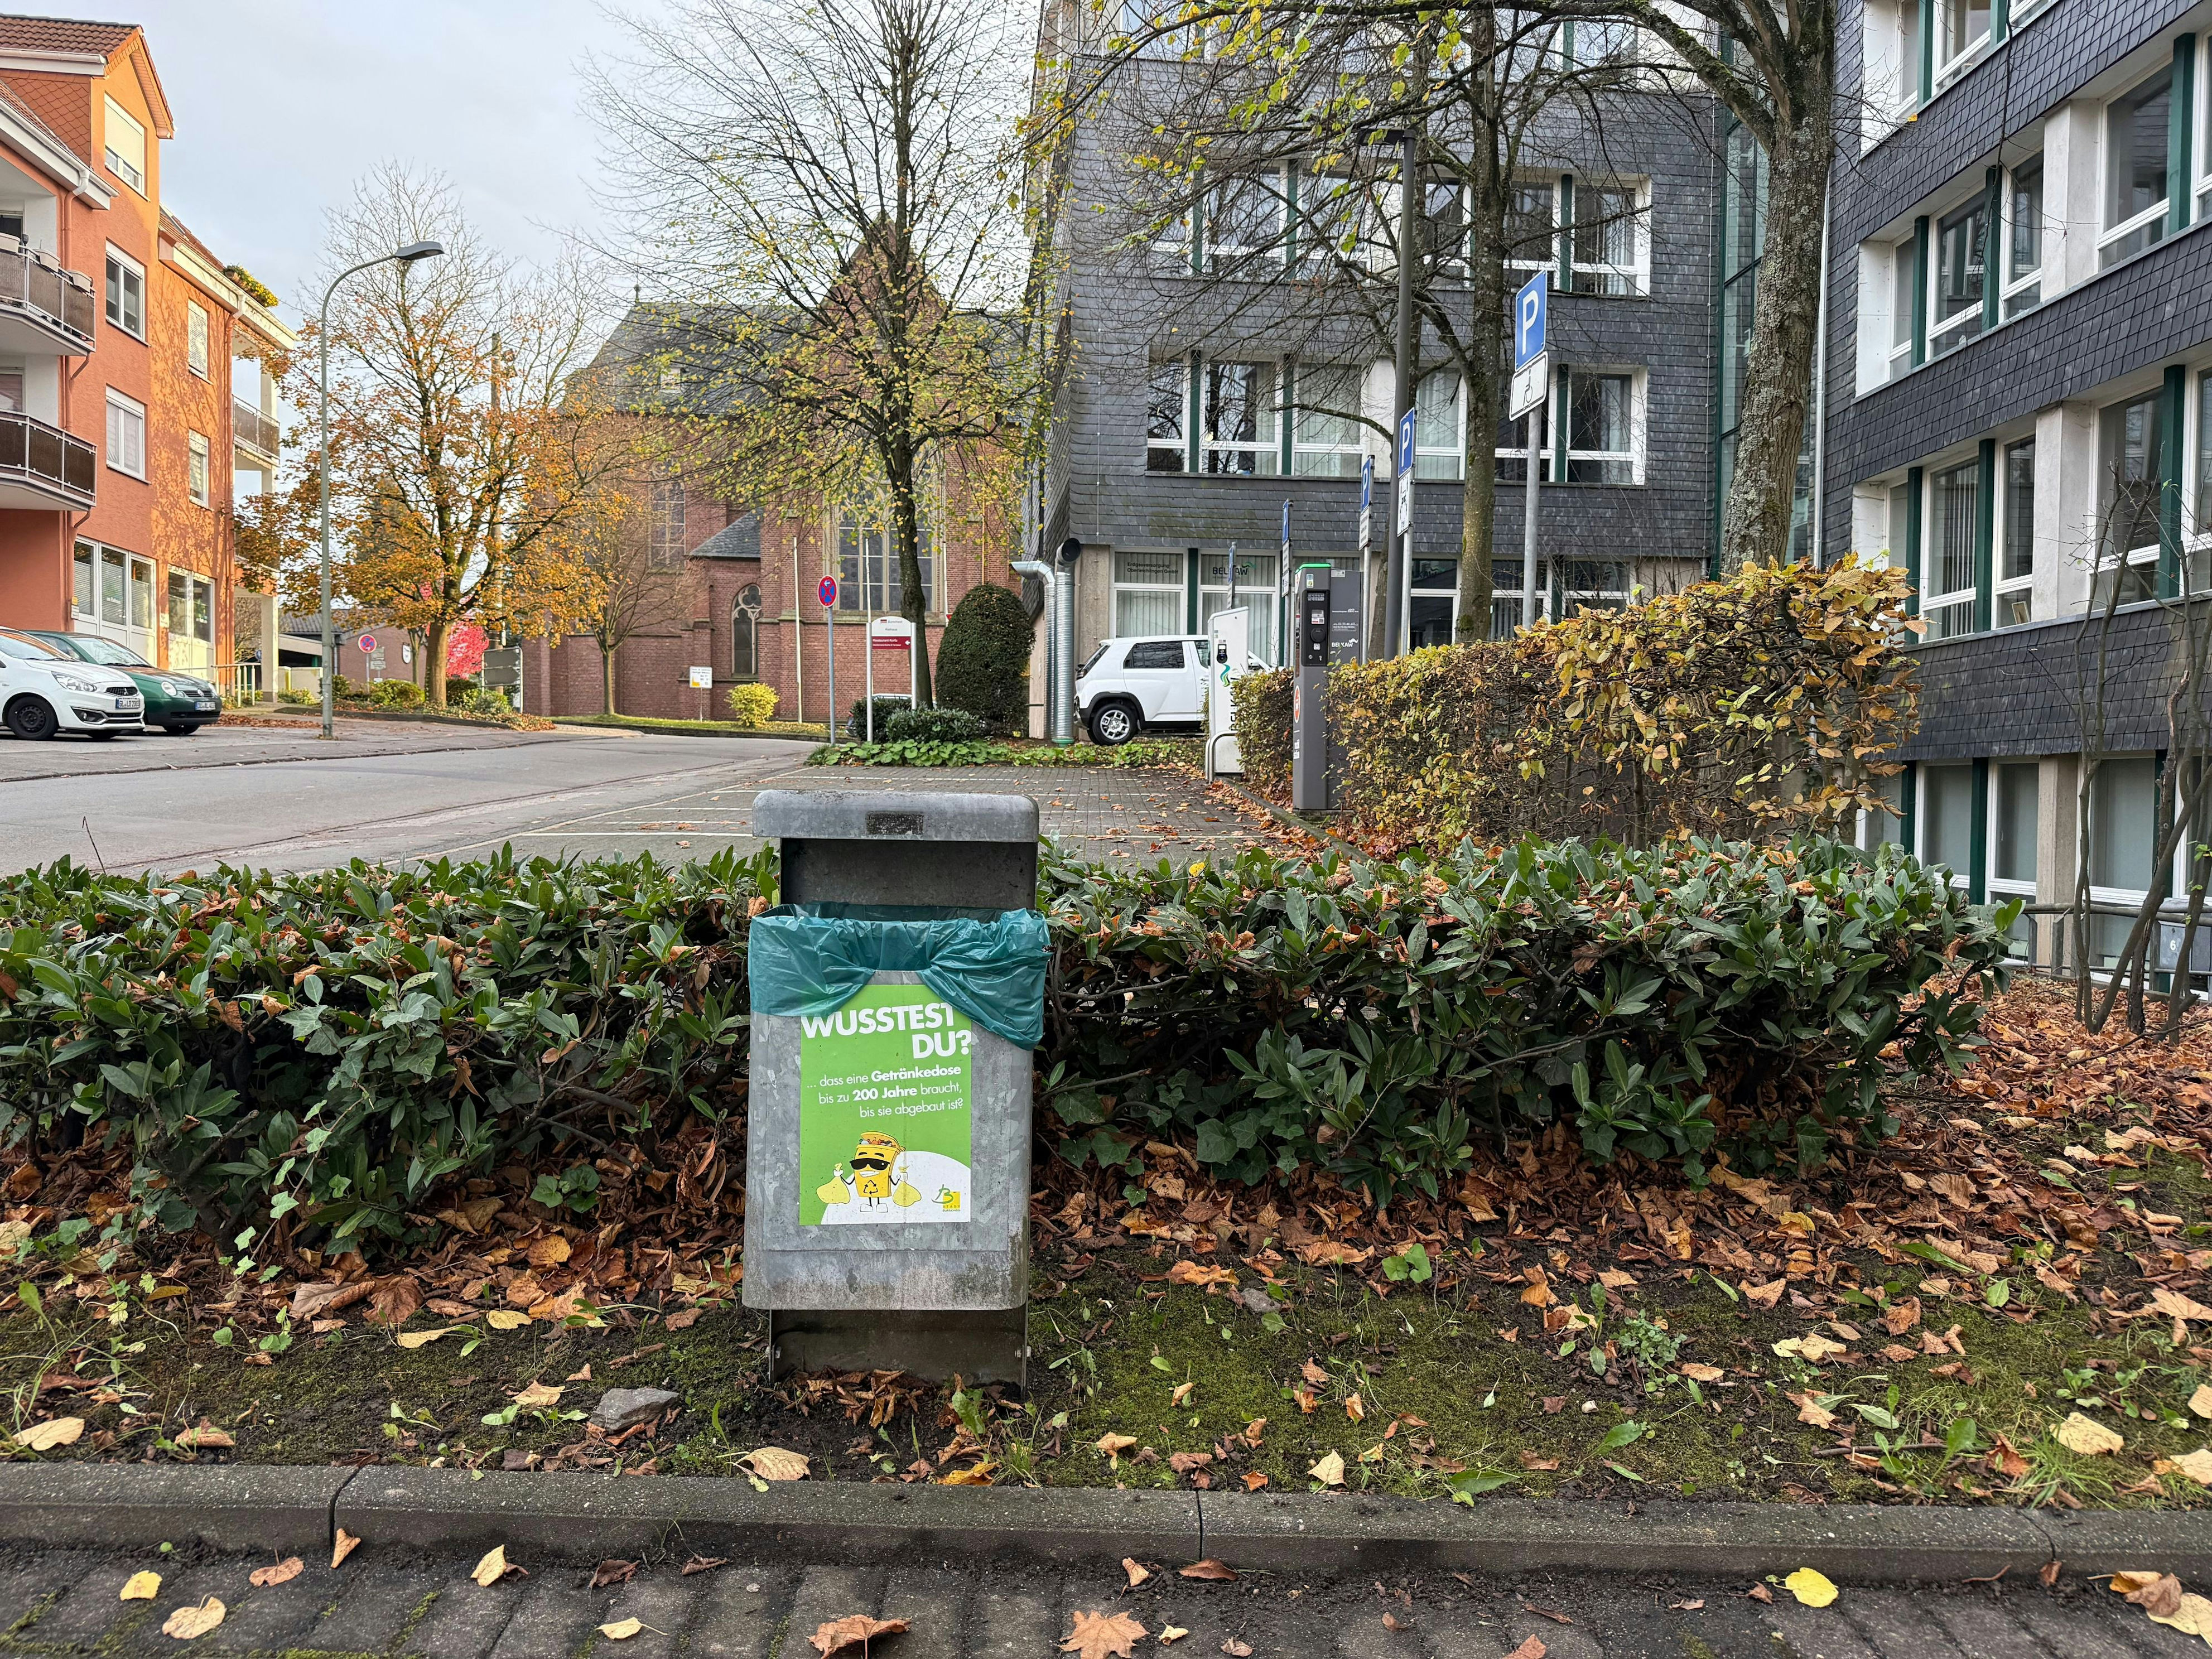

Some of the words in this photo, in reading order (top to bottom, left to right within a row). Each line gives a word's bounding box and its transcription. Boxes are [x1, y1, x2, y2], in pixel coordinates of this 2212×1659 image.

[1521, 290, 1539, 355] P
[1401, 421, 1410, 467] P
[1362, 469, 1368, 505] P
[1212, 567, 1248, 575] BELAW
[2170, 939, 2176, 951] 6
[801, 1002, 954, 1038] WUSSTEST
[912, 1029, 972, 1059] DU?
[820, 1074, 844, 1087] dass
[846, 1073, 869, 1084] eine
[871, 1064, 962, 1082] Getränkedose
[818, 1092, 834, 1105] bis
[837, 1094, 850, 1103] zu
[852, 1088, 879, 1101] 200
[881, 1085, 918, 1099] Jahre
[921, 1080, 962, 1096] braucht,
[860, 1105, 875, 1118] bis
[878, 1105, 892, 1116] sie
[894, 1100, 946, 1117] abgebaut
[948, 1097, 963, 1110] ist?
